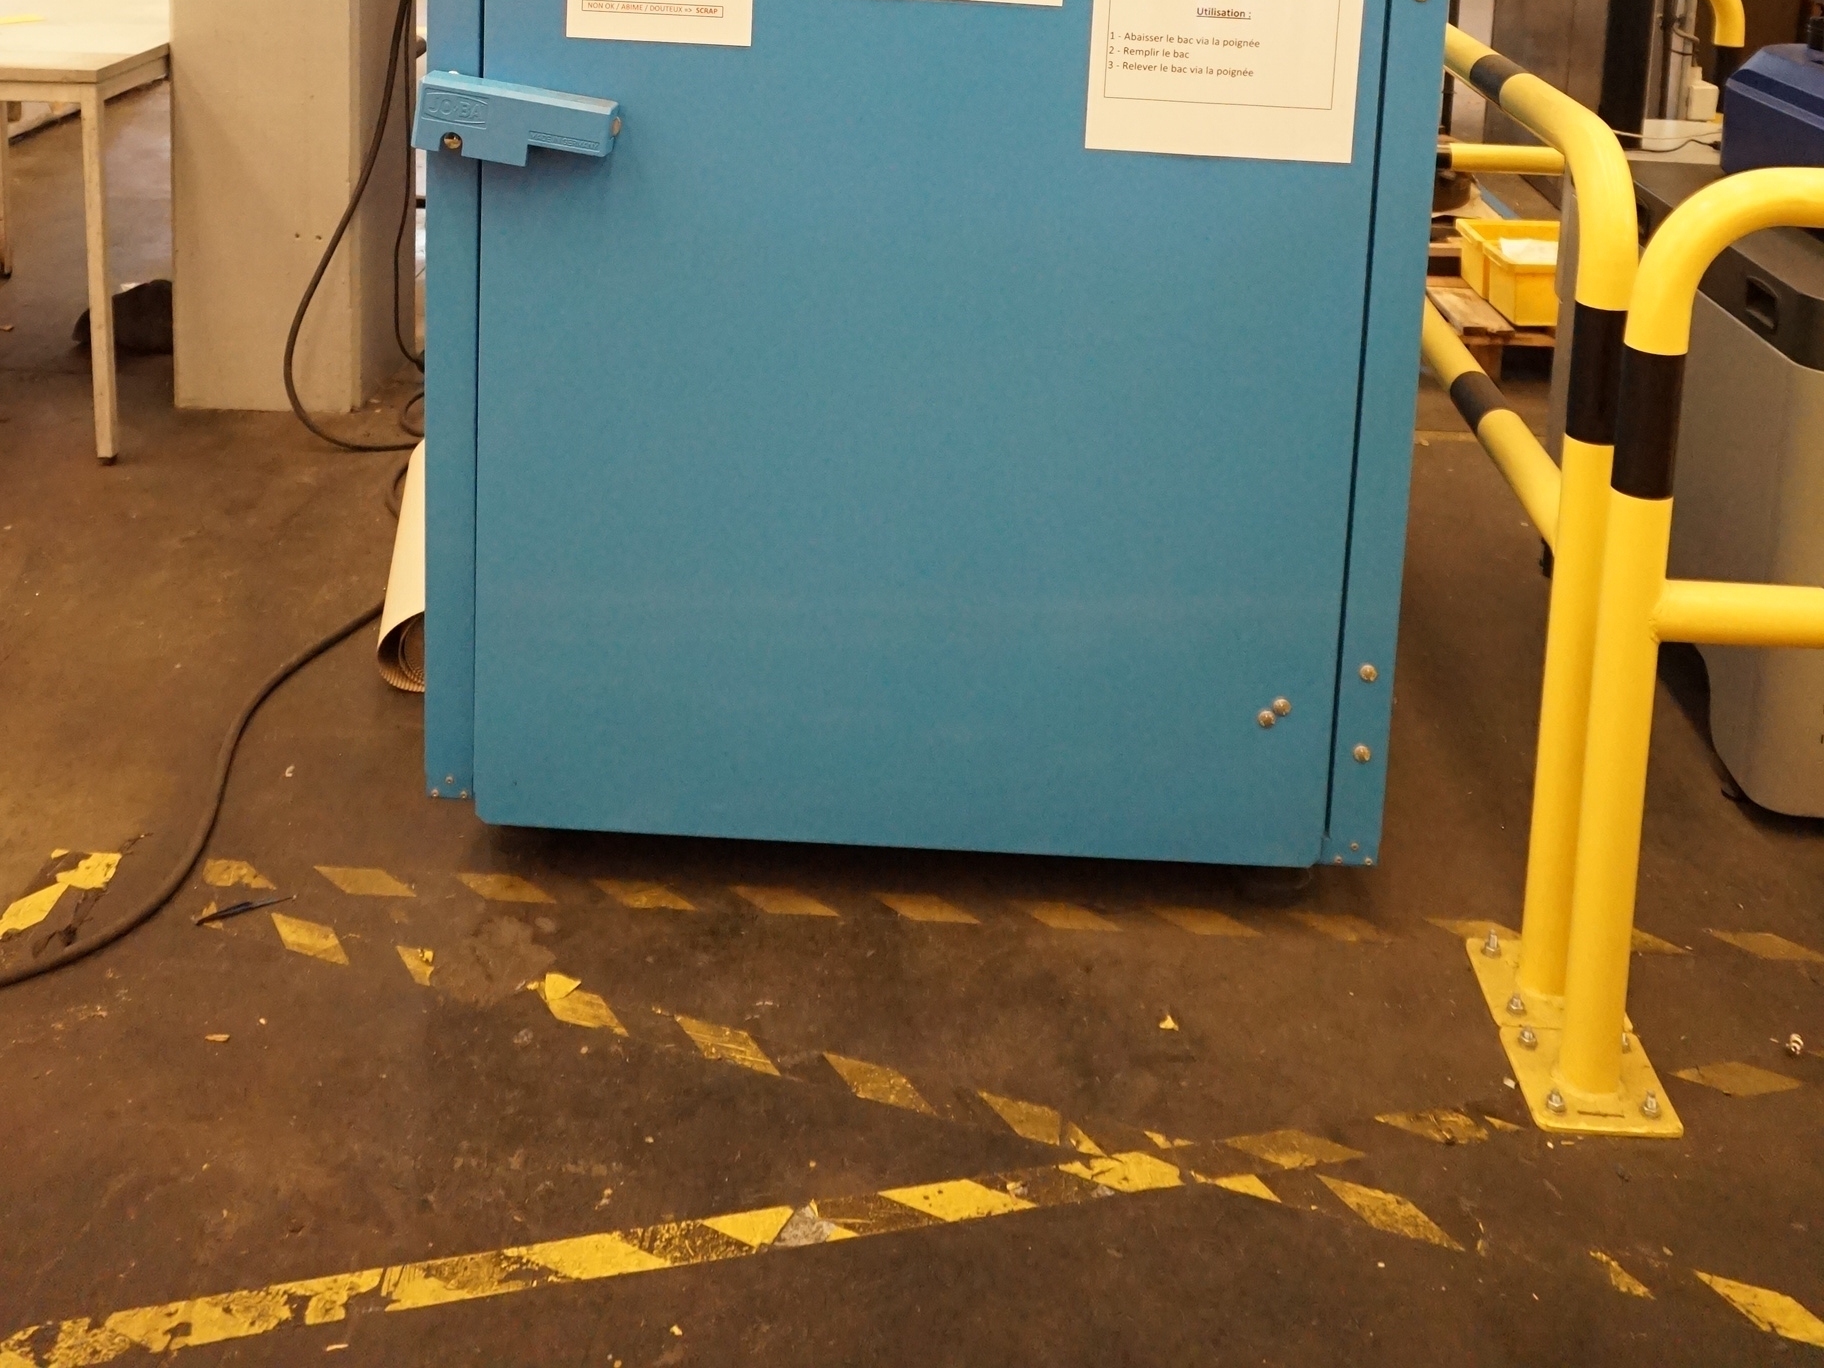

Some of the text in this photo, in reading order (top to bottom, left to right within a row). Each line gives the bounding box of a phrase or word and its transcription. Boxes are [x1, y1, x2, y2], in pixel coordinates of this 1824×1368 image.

[621, 3, 643, 11] ABIME
[649, 5, 683, 13] DOUTEUX
[695, 7, 718, 15] SCRAP
[1196, 7, 1246, 18] Utilisation
[1110, 32, 1115, 40] 1
[1124, 32, 1163, 43] Abaisser
[1166, 34, 1175, 43] le
[1177, 35, 1194, 45] bac
[1195, 37, 1210, 46] via
[1212, 37, 1220, 46] la
[1222, 38, 1260, 48] poignée
[1109, 46, 1115, 55] 2
[1123, 47, 1160, 58] Remplir
[1162, 49, 1171, 57] le
[1173, 50, 1190, 59] bac
[1108, 61, 1114, 70] 3
[1122, 61, 1157, 72] Relever
[1160, 63, 1169, 72] le
[1171, 64, 1187, 74] bac
[1190, 66, 1203, 75] via
[1205, 66, 1214, 75] la
[1216, 67, 1254, 78] poignée
